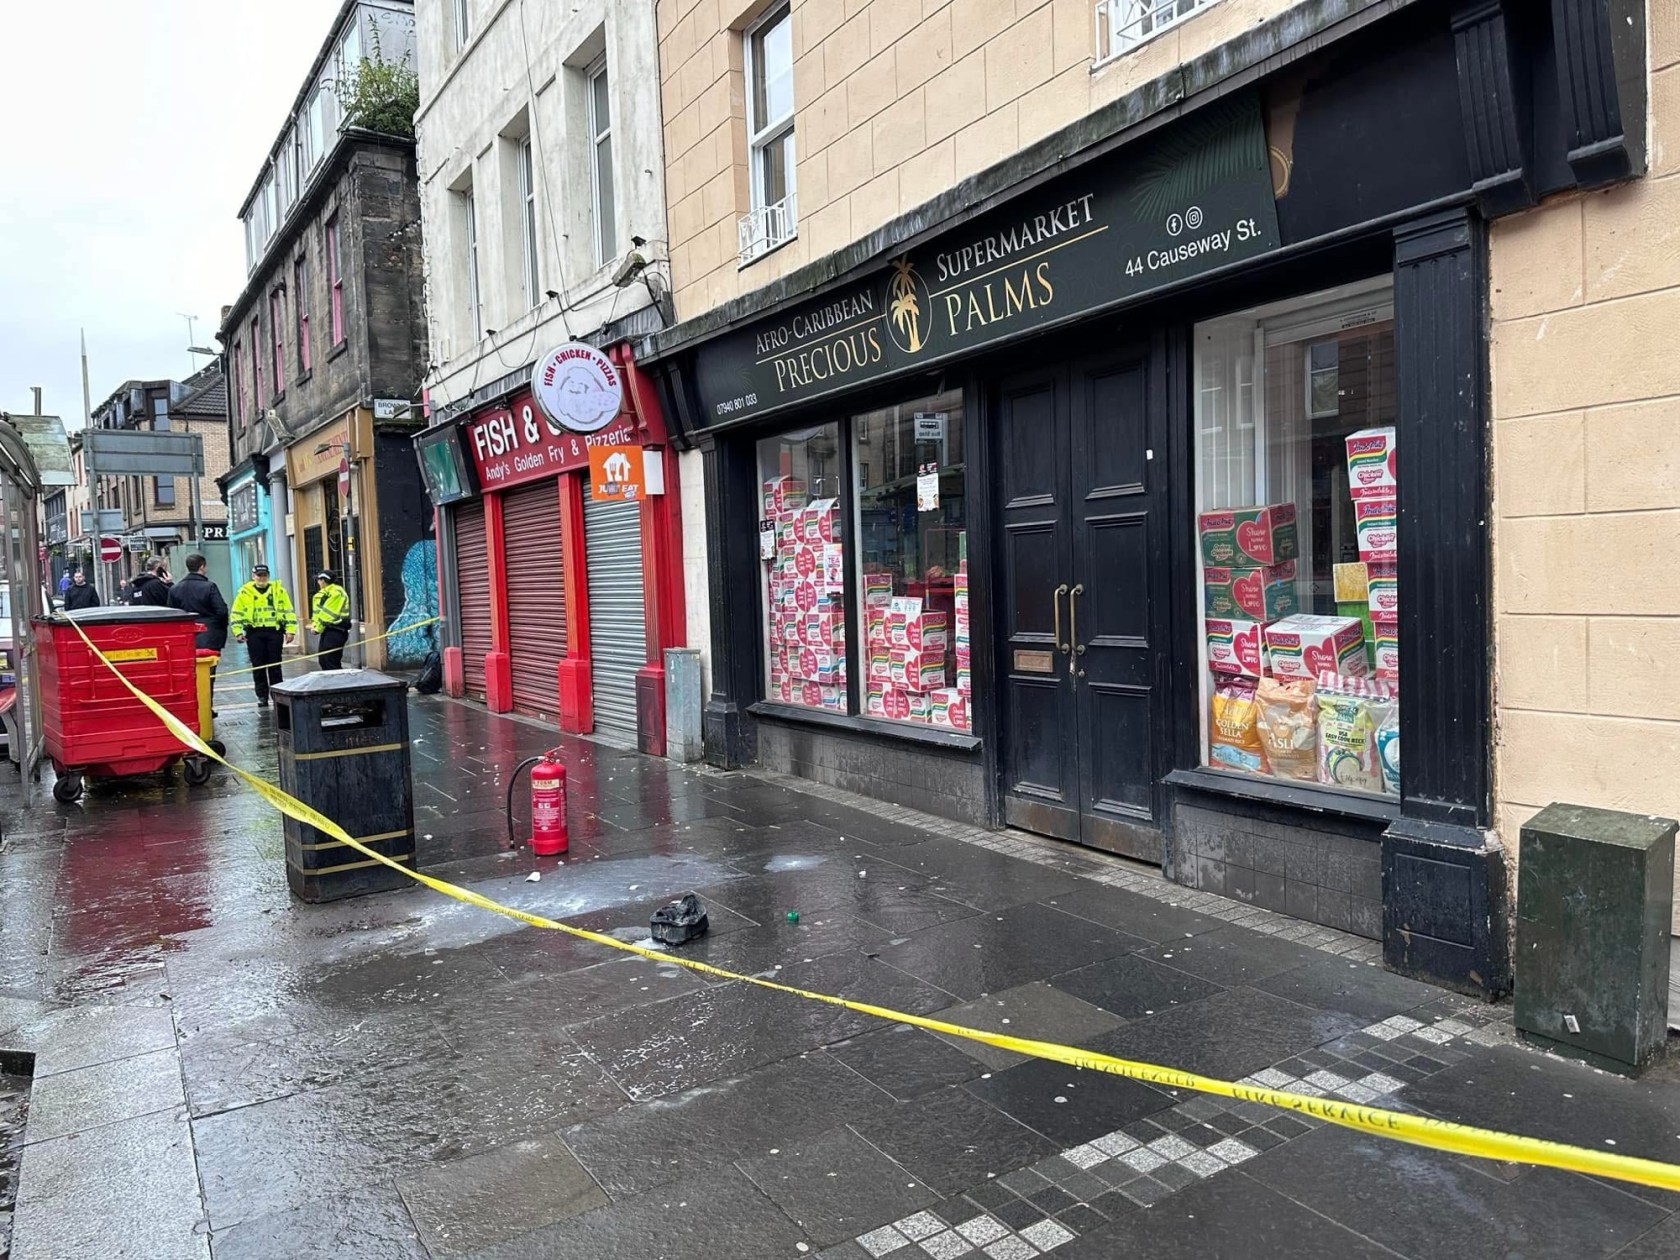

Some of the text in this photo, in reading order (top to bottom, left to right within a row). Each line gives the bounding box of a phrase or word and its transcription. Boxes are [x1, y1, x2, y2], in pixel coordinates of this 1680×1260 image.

[756, 194, 1094, 355] AFRO-CARIBBEAN SUPERMARKET
[1125, 218, 1262, 277] 44 Causeway St.
[775, 262, 1054, 392] PRECIOUS PALMS
[544, 349, 617, 387] FISH CHICKEN PIZZAS
[717, 393, 757, 415] 07940 801 033
[473, 405, 540, 461] FISH &
[485, 461, 511, 481] Andy's
[514, 452, 544, 472] Golden
[548, 445, 564, 463] Fry
[571, 439, 579, 456] &
[585, 425, 632, 449] Pizzeria
[1216, 719, 1249, 731] GOLDEN
[1220, 727, 1242, 738] SELLA
